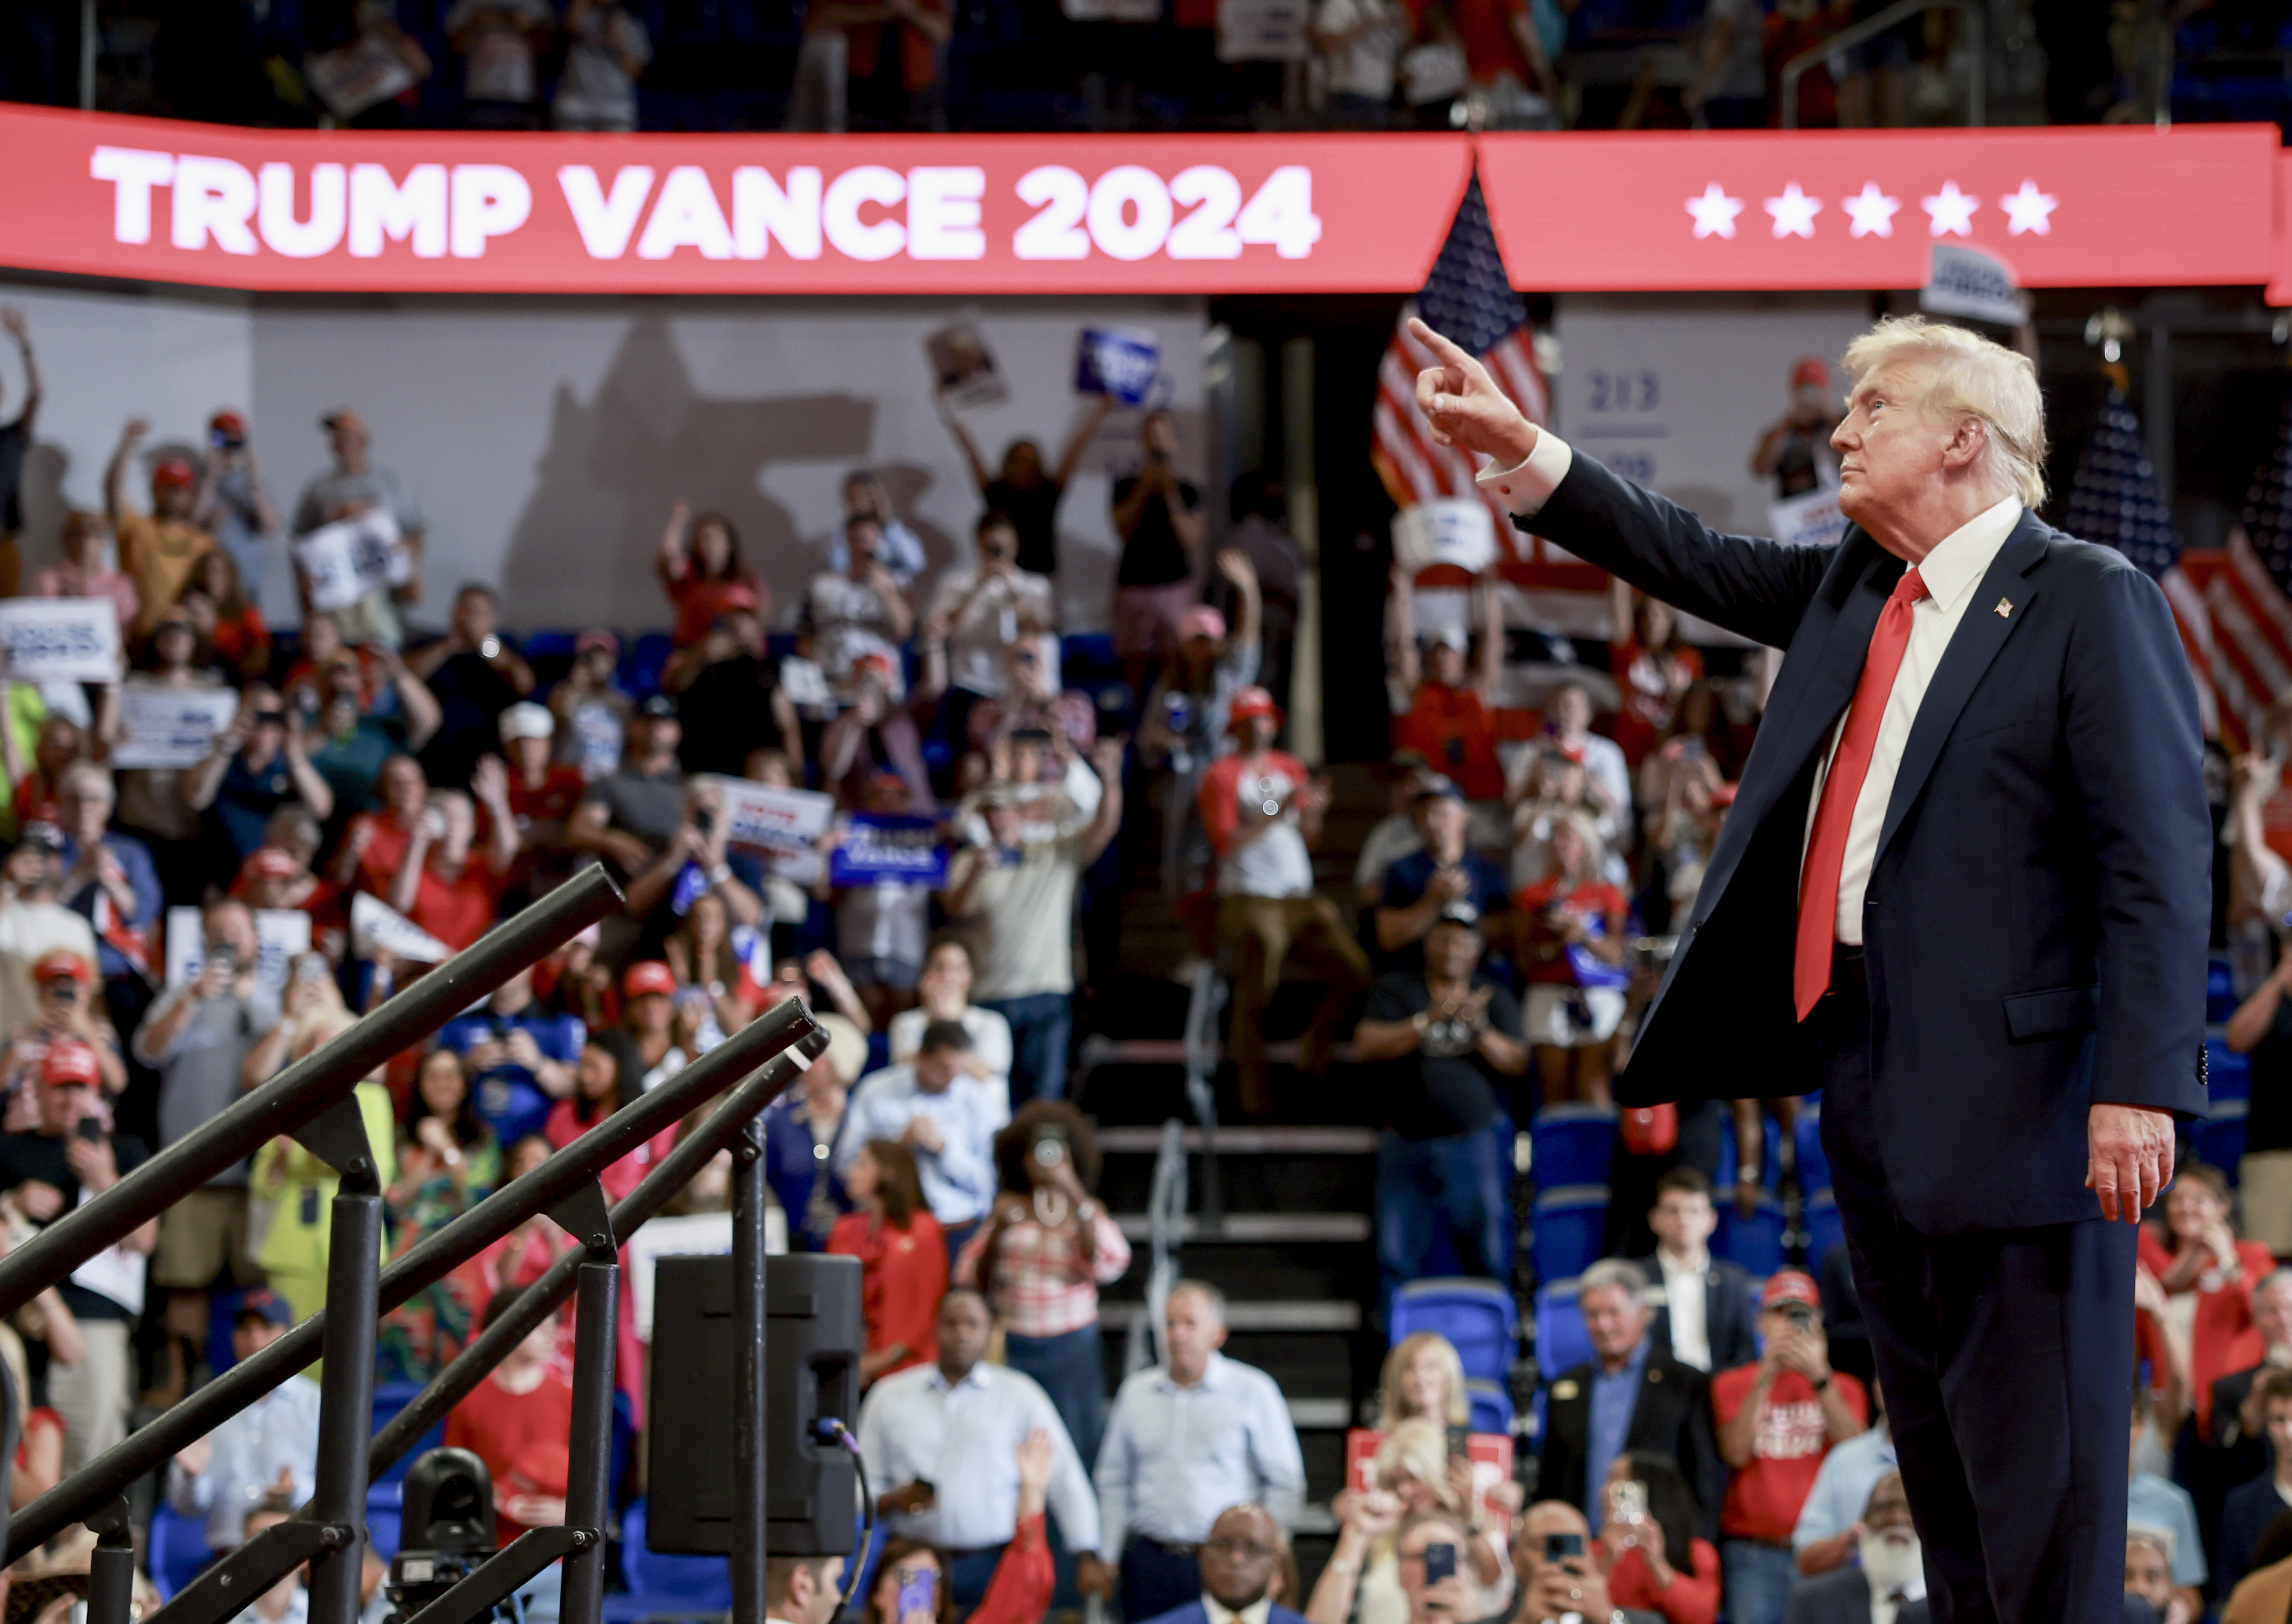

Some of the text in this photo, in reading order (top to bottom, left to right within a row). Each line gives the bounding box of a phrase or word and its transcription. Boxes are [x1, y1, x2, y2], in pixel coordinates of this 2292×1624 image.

[91, 147, 1321, 261] TRUMP VANCE 2024
[1587, 369, 1660, 412] 213
